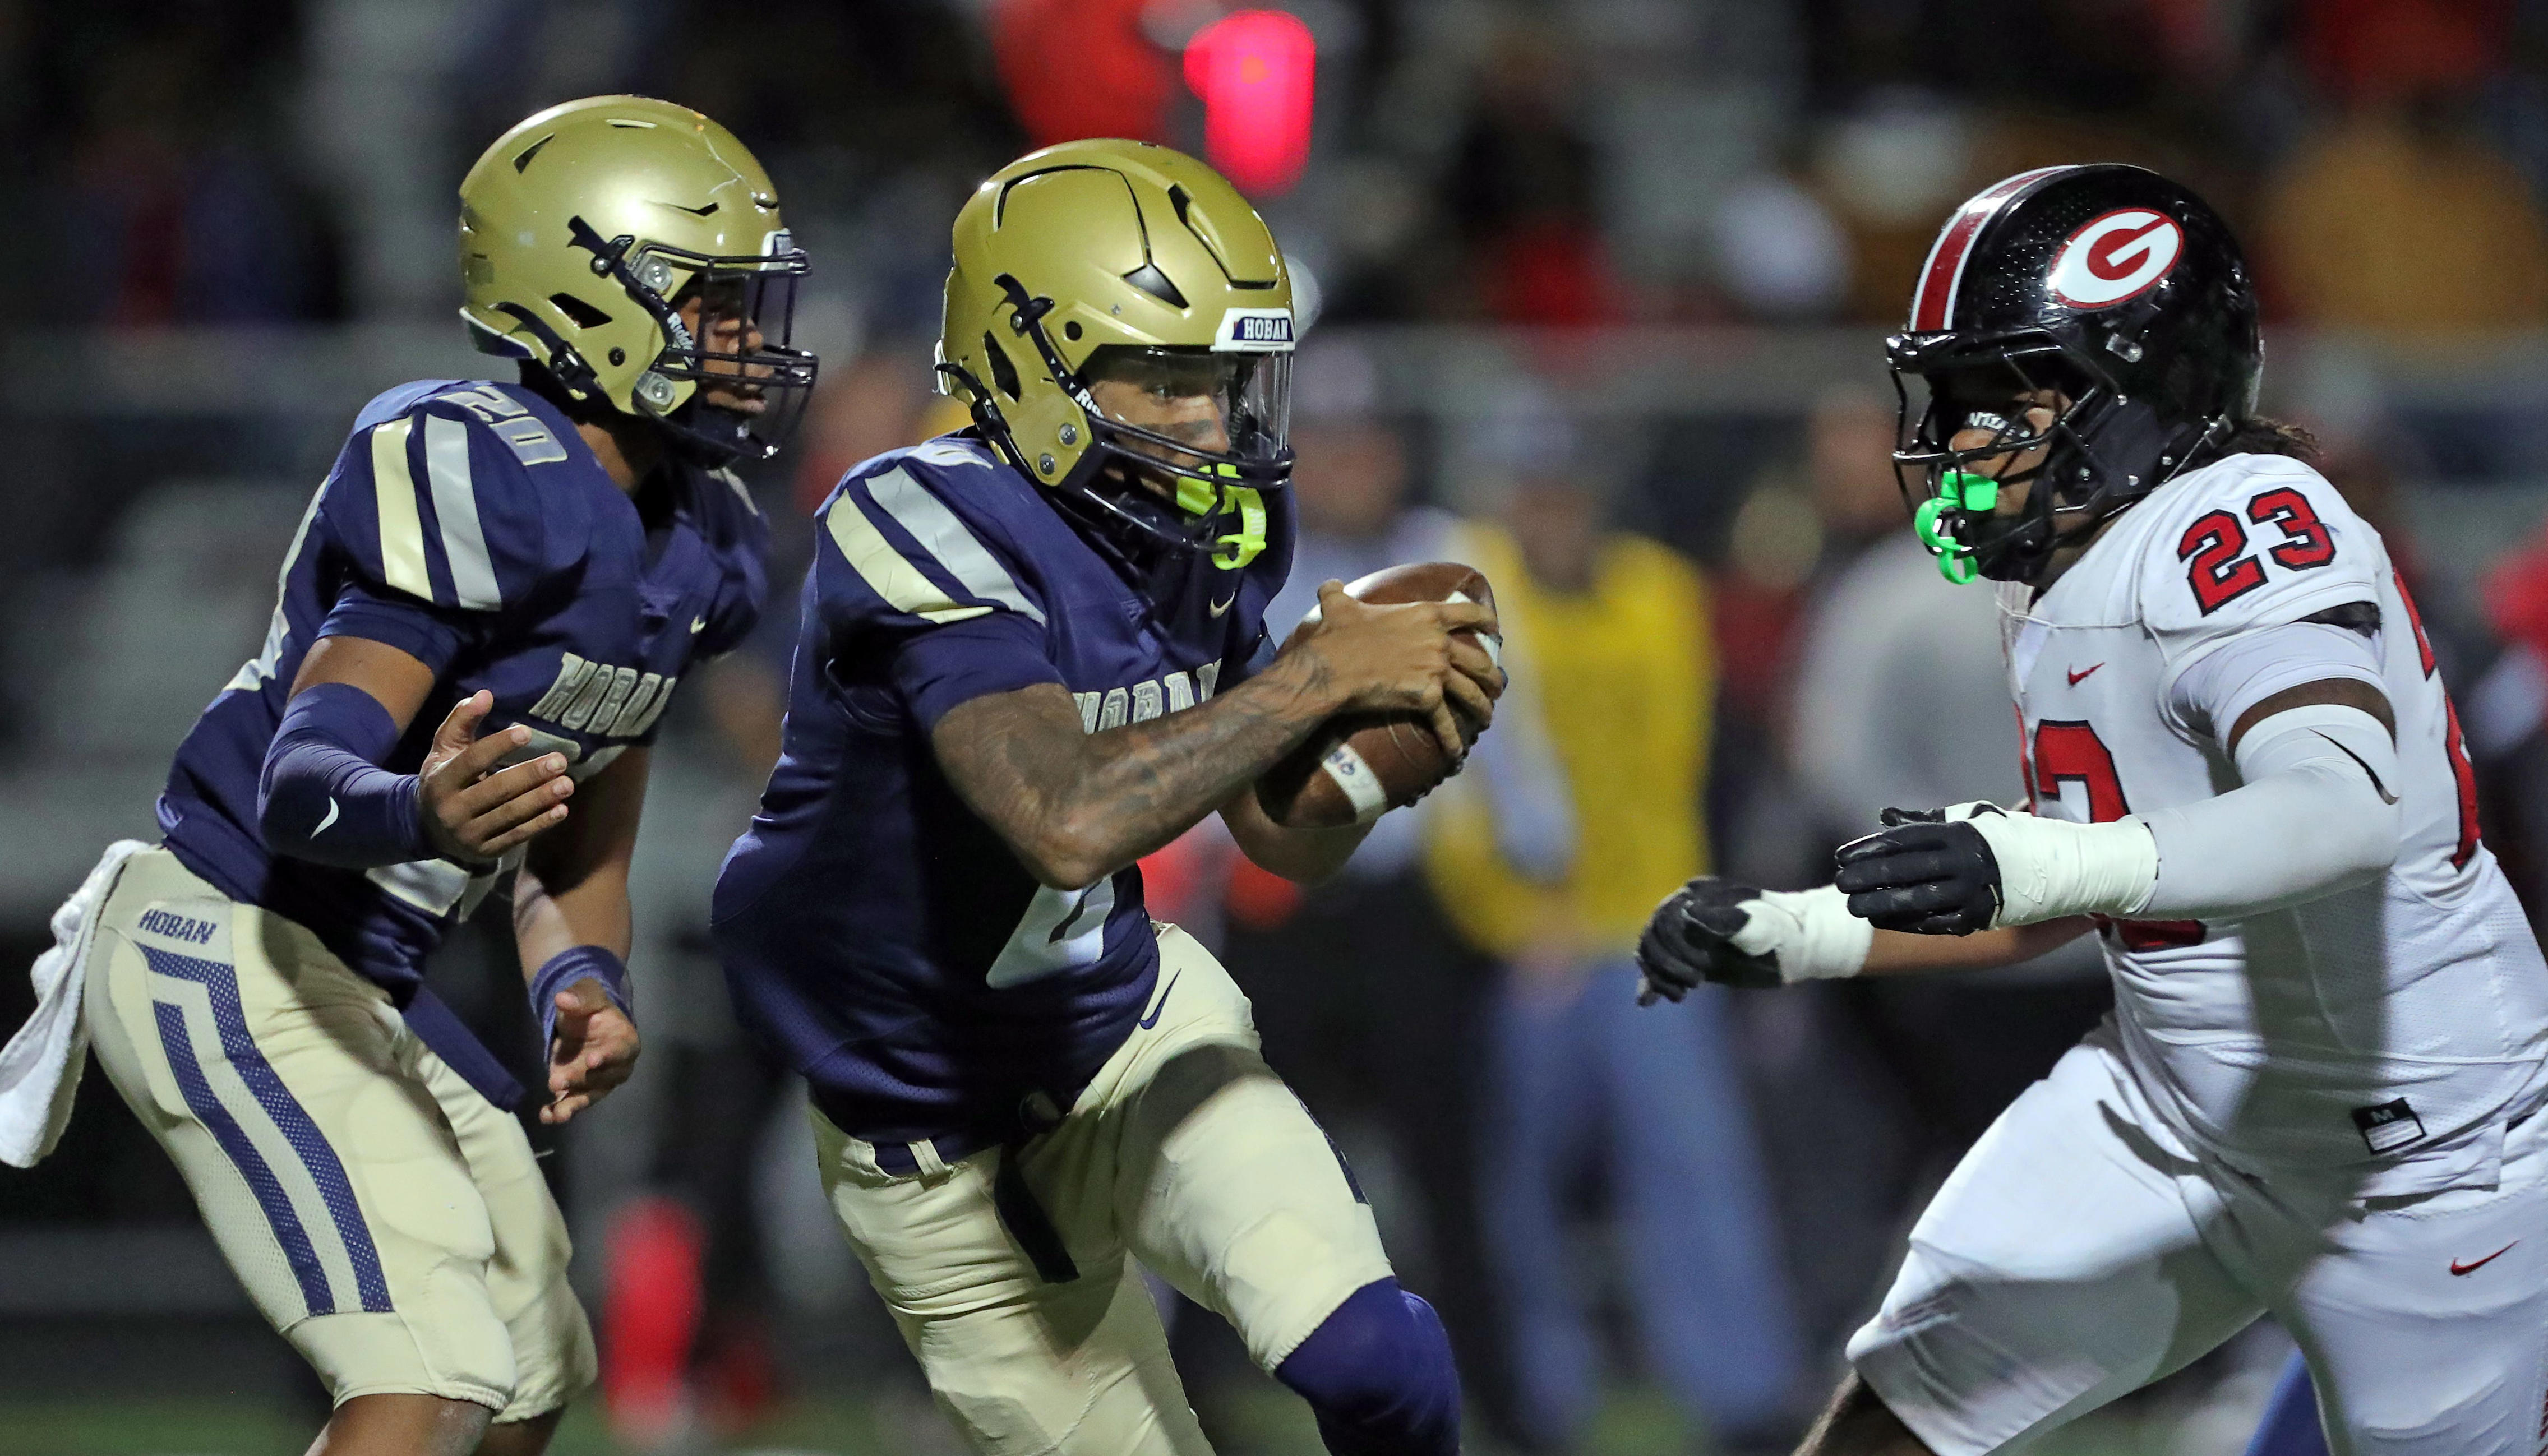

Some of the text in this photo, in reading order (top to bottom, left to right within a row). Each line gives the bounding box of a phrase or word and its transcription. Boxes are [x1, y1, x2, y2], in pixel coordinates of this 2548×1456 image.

[2047, 207, 2185, 309] G
[1243, 318, 1289, 340] HOBAN
[435, 386, 568, 466] 20
[2177, 487, 2337, 618] 23
[138, 908, 218, 944] HOBAN
